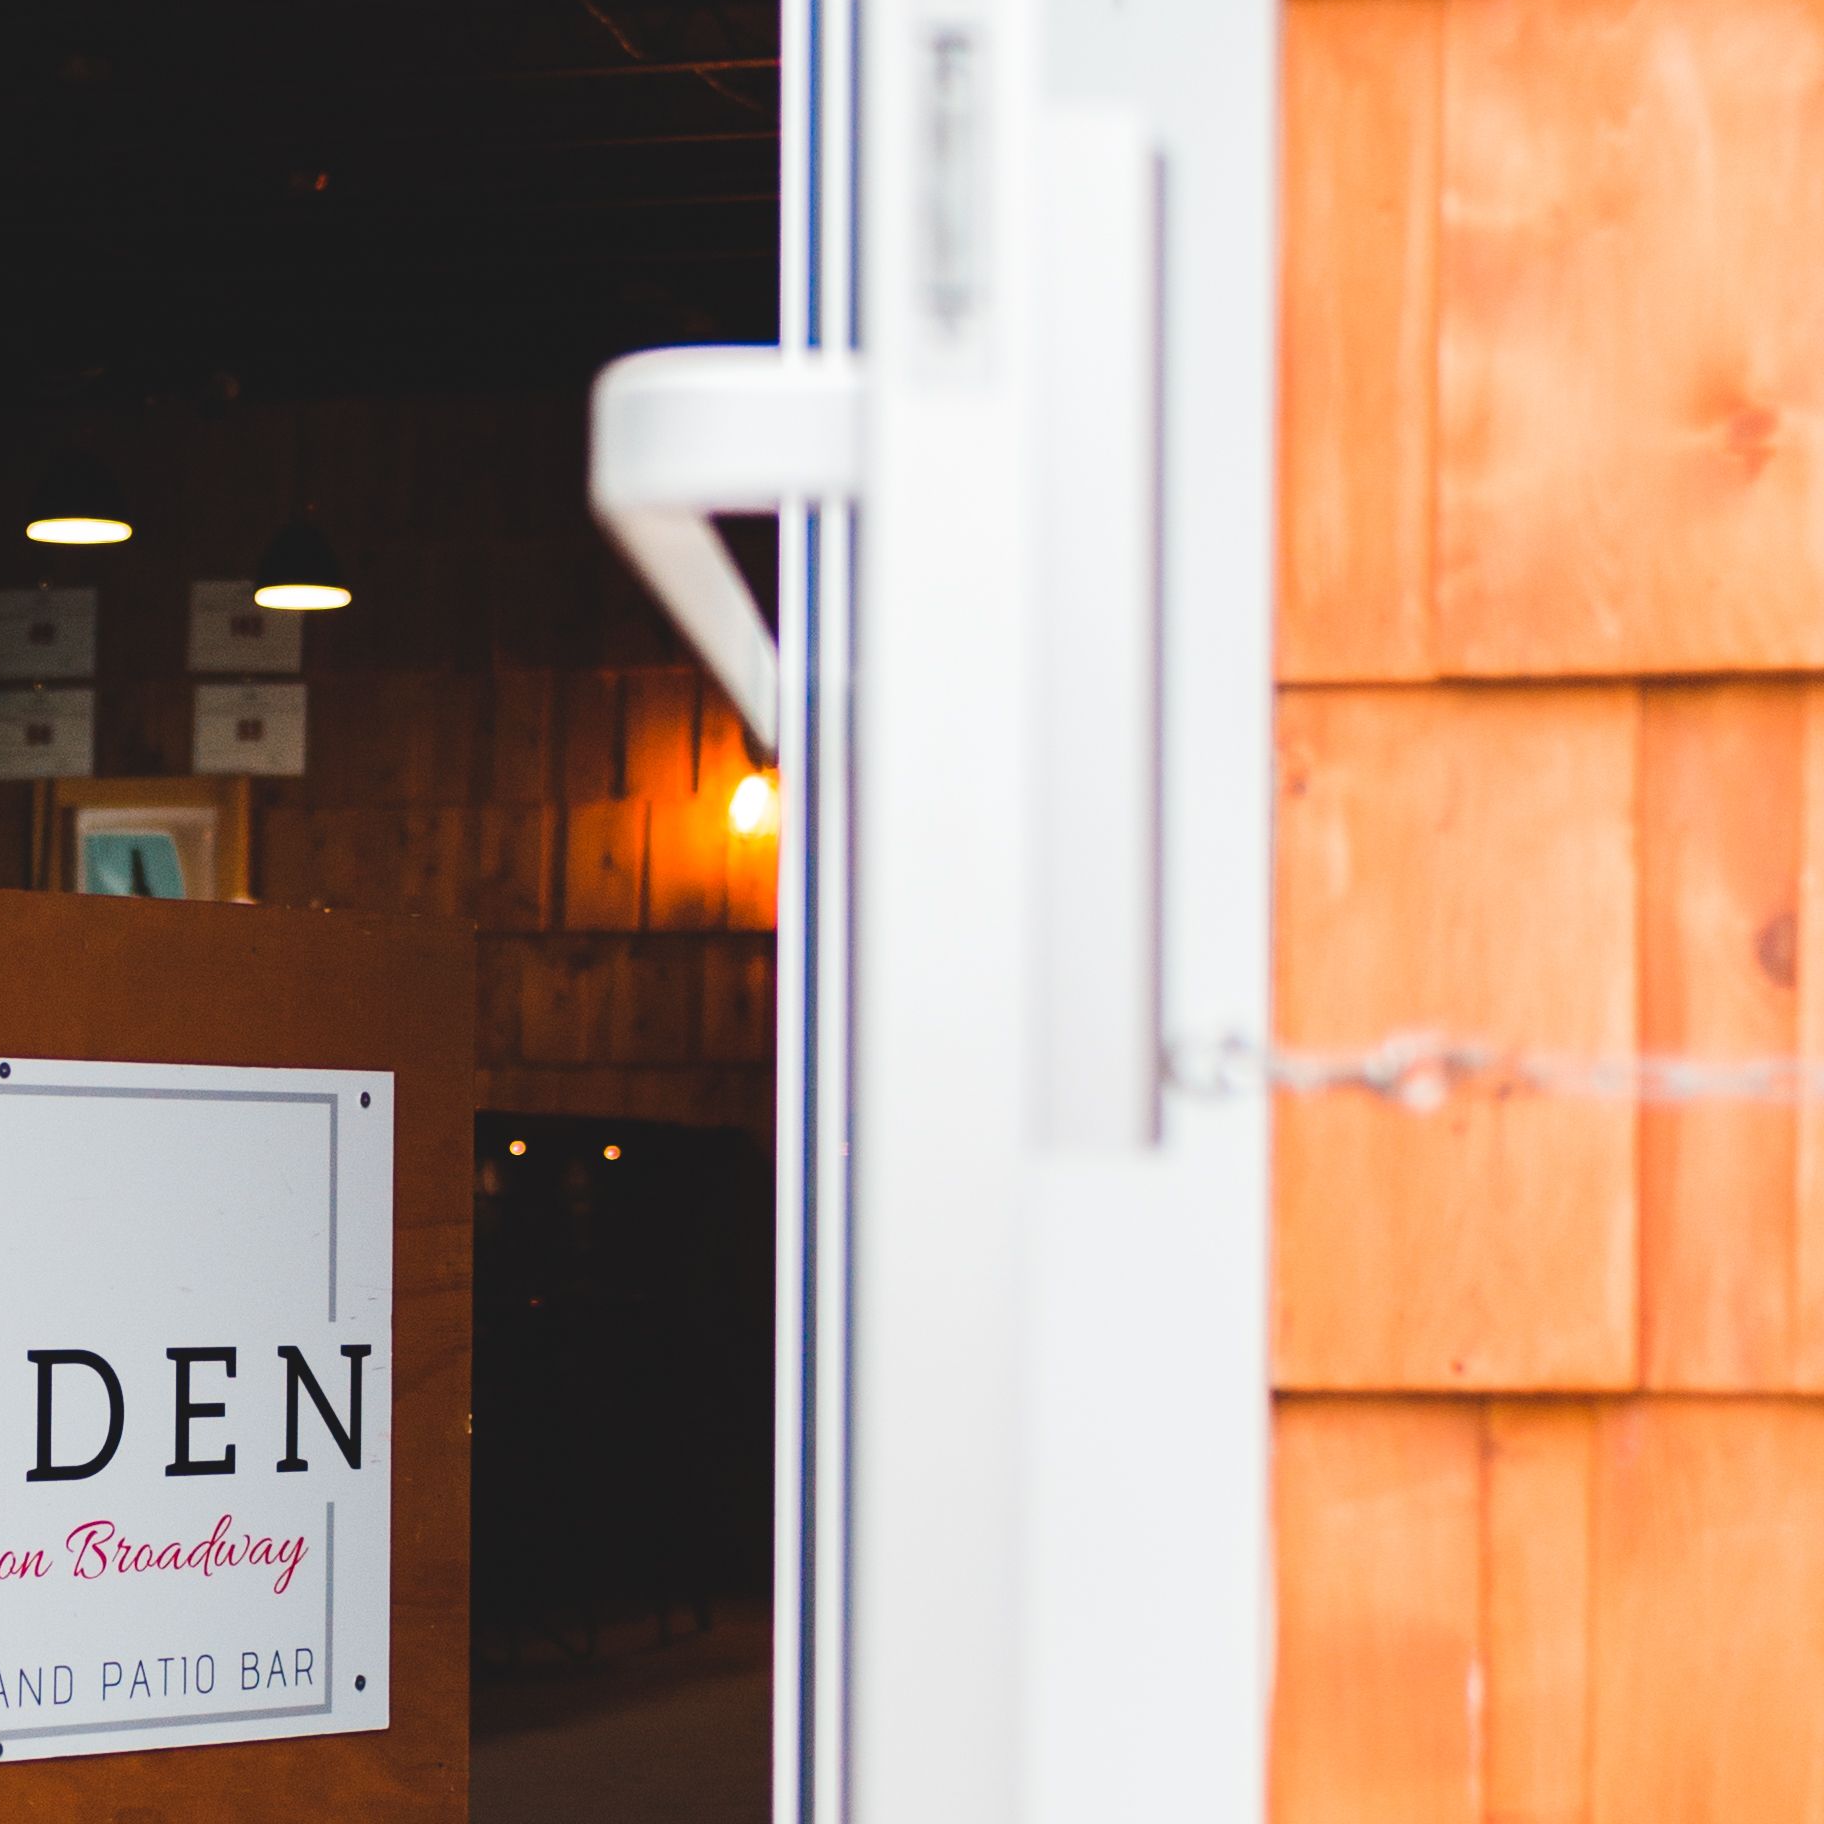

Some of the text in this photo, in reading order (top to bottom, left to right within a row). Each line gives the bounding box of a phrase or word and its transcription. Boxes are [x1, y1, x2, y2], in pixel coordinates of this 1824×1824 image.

[65, 1515, 308, 1595] Broadway
[102, 1654, 215, 1701] PATIO
[240, 1648, 315, 1690] BAR
